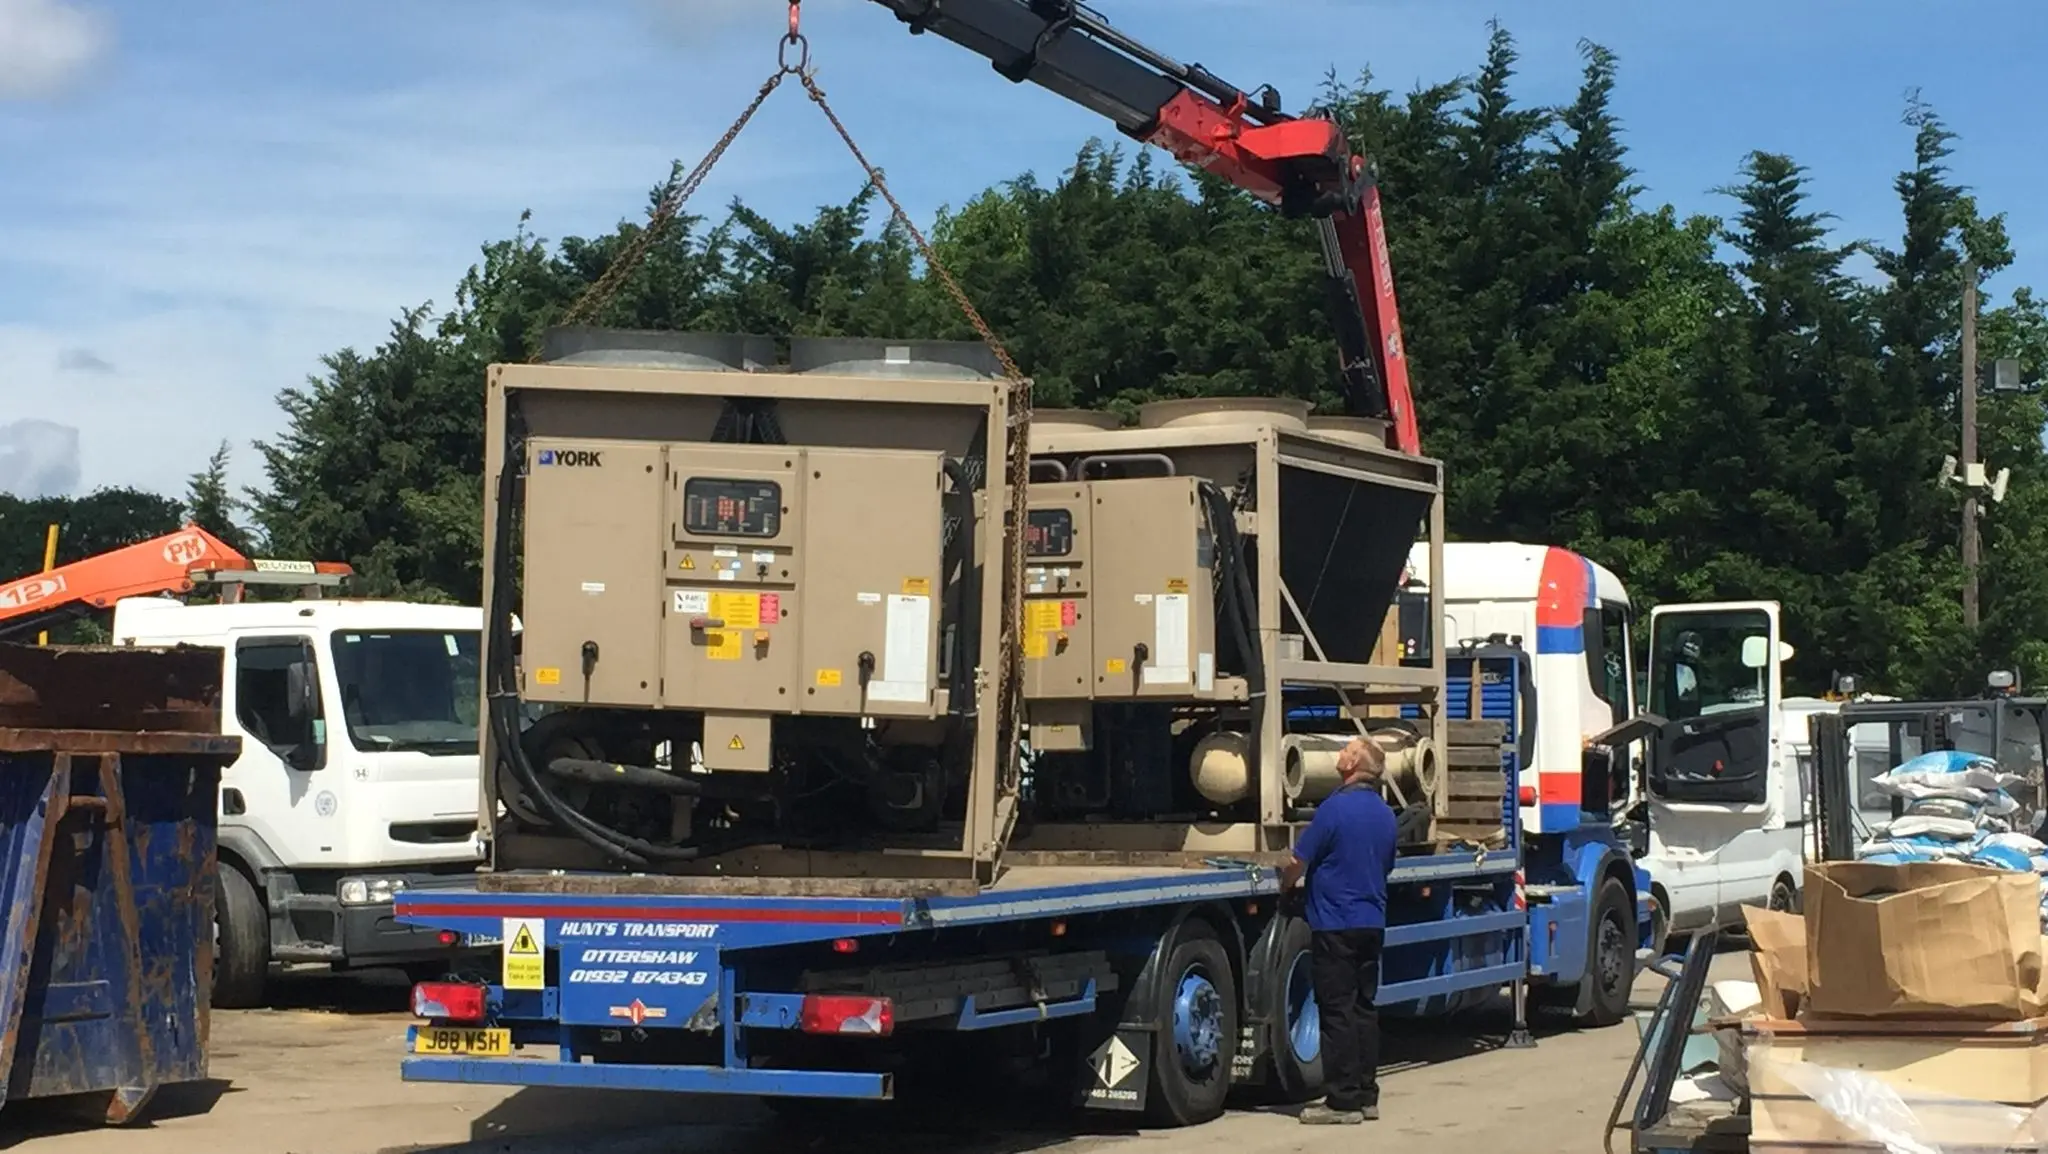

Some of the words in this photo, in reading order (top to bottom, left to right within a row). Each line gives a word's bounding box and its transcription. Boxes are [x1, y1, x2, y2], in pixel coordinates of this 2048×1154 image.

[554, 450, 602, 467] YORK
[168, 538, 202, 563] PM
[560, 922, 617, 937] HUNT'S
[623, 922, 719, 938] TRANSPORT
[582, 949, 697, 965] OTTERSHAW
[569, 969, 626, 984] 01932
[631, 971, 708, 986] 874343
[425, 1031, 460, 1051] J88
[464, 1031, 500, 1051] WSH
